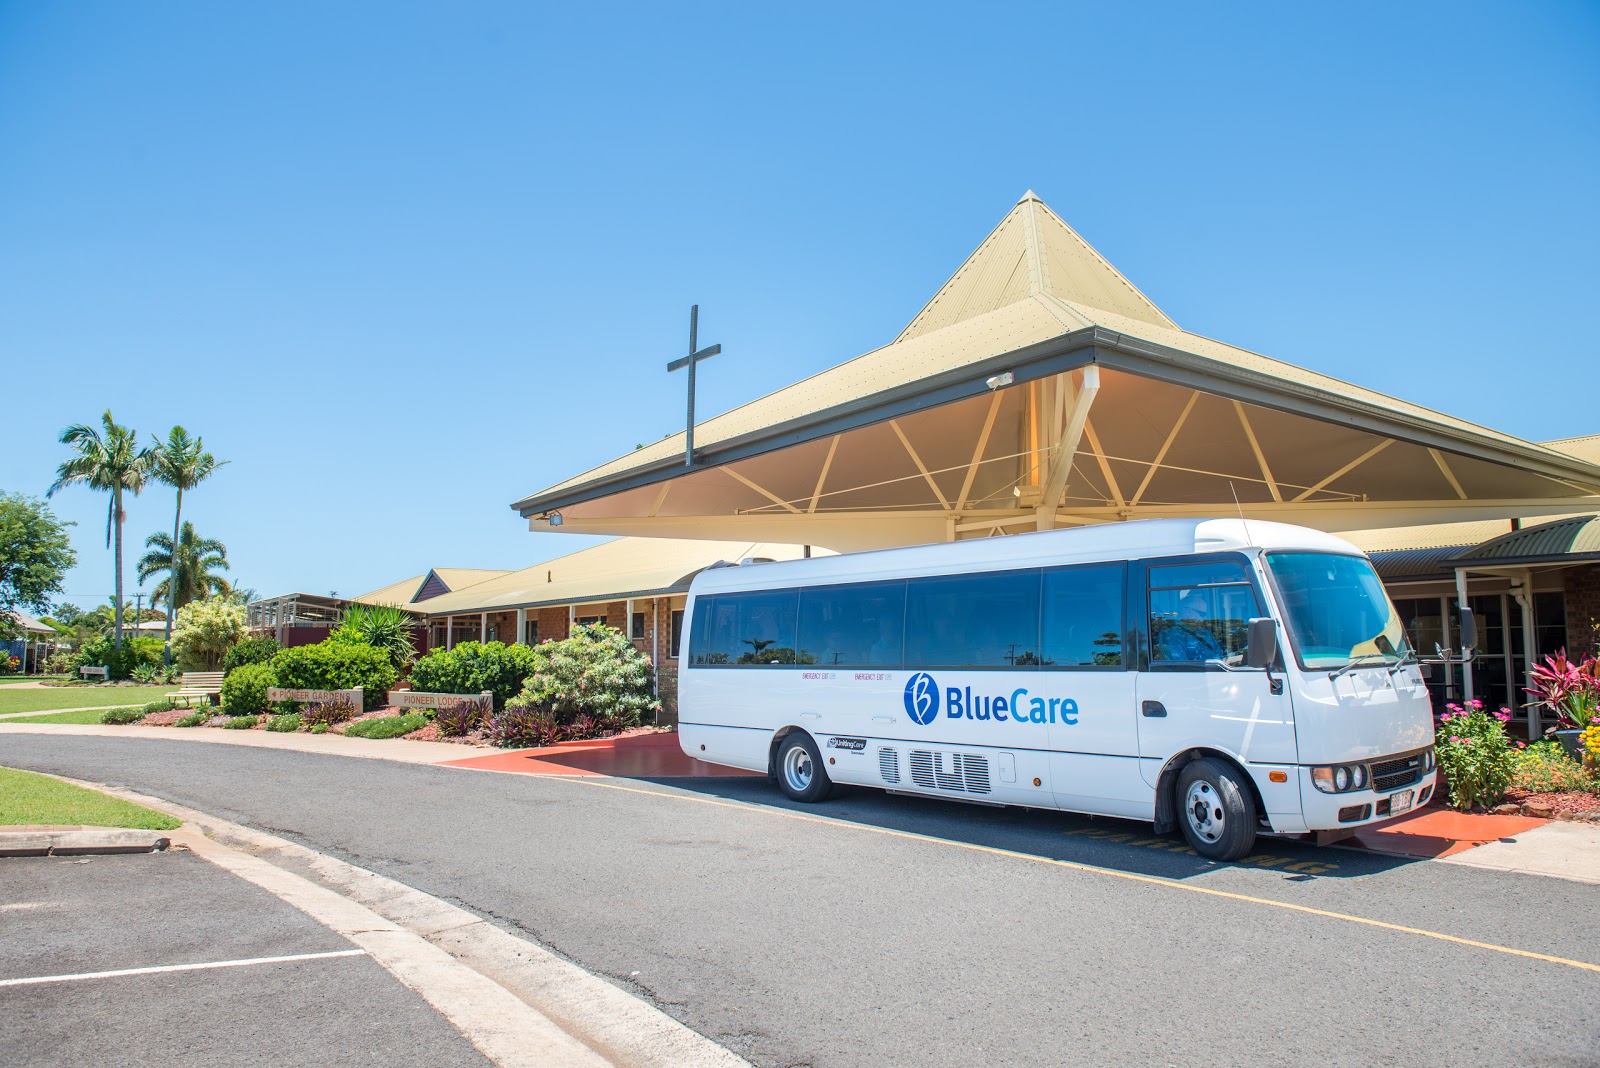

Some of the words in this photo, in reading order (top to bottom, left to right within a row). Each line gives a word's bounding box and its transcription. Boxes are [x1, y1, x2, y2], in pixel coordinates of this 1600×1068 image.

[279, 690, 310, 700] PIONEER
[312, 691, 351, 701] GARDENS
[403, 695, 435, 705] PIONEER
[438, 697, 462, 706] LODGE
[946, 686, 1079, 725] BlueCare
